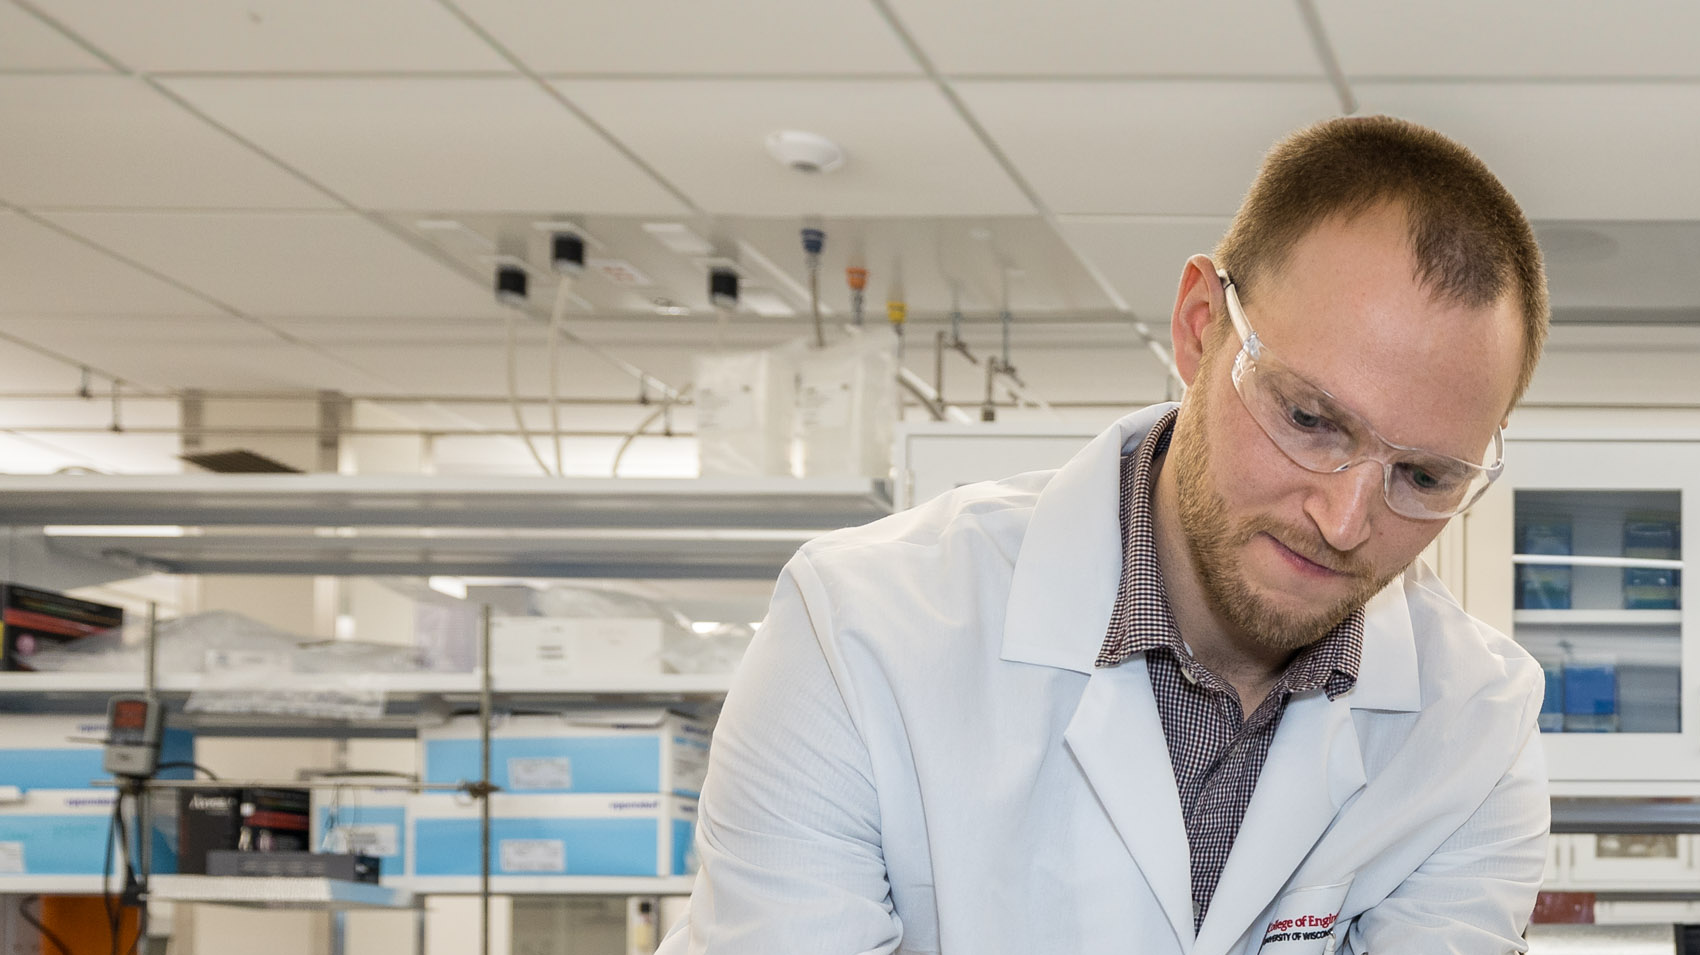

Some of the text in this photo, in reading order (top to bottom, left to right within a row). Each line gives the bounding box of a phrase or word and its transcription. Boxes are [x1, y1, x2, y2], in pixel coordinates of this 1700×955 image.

[1295, 916, 1307, 927] of
[1308, 914, 1338, 929] Engin
[1291, 931, 1302, 941] OF
